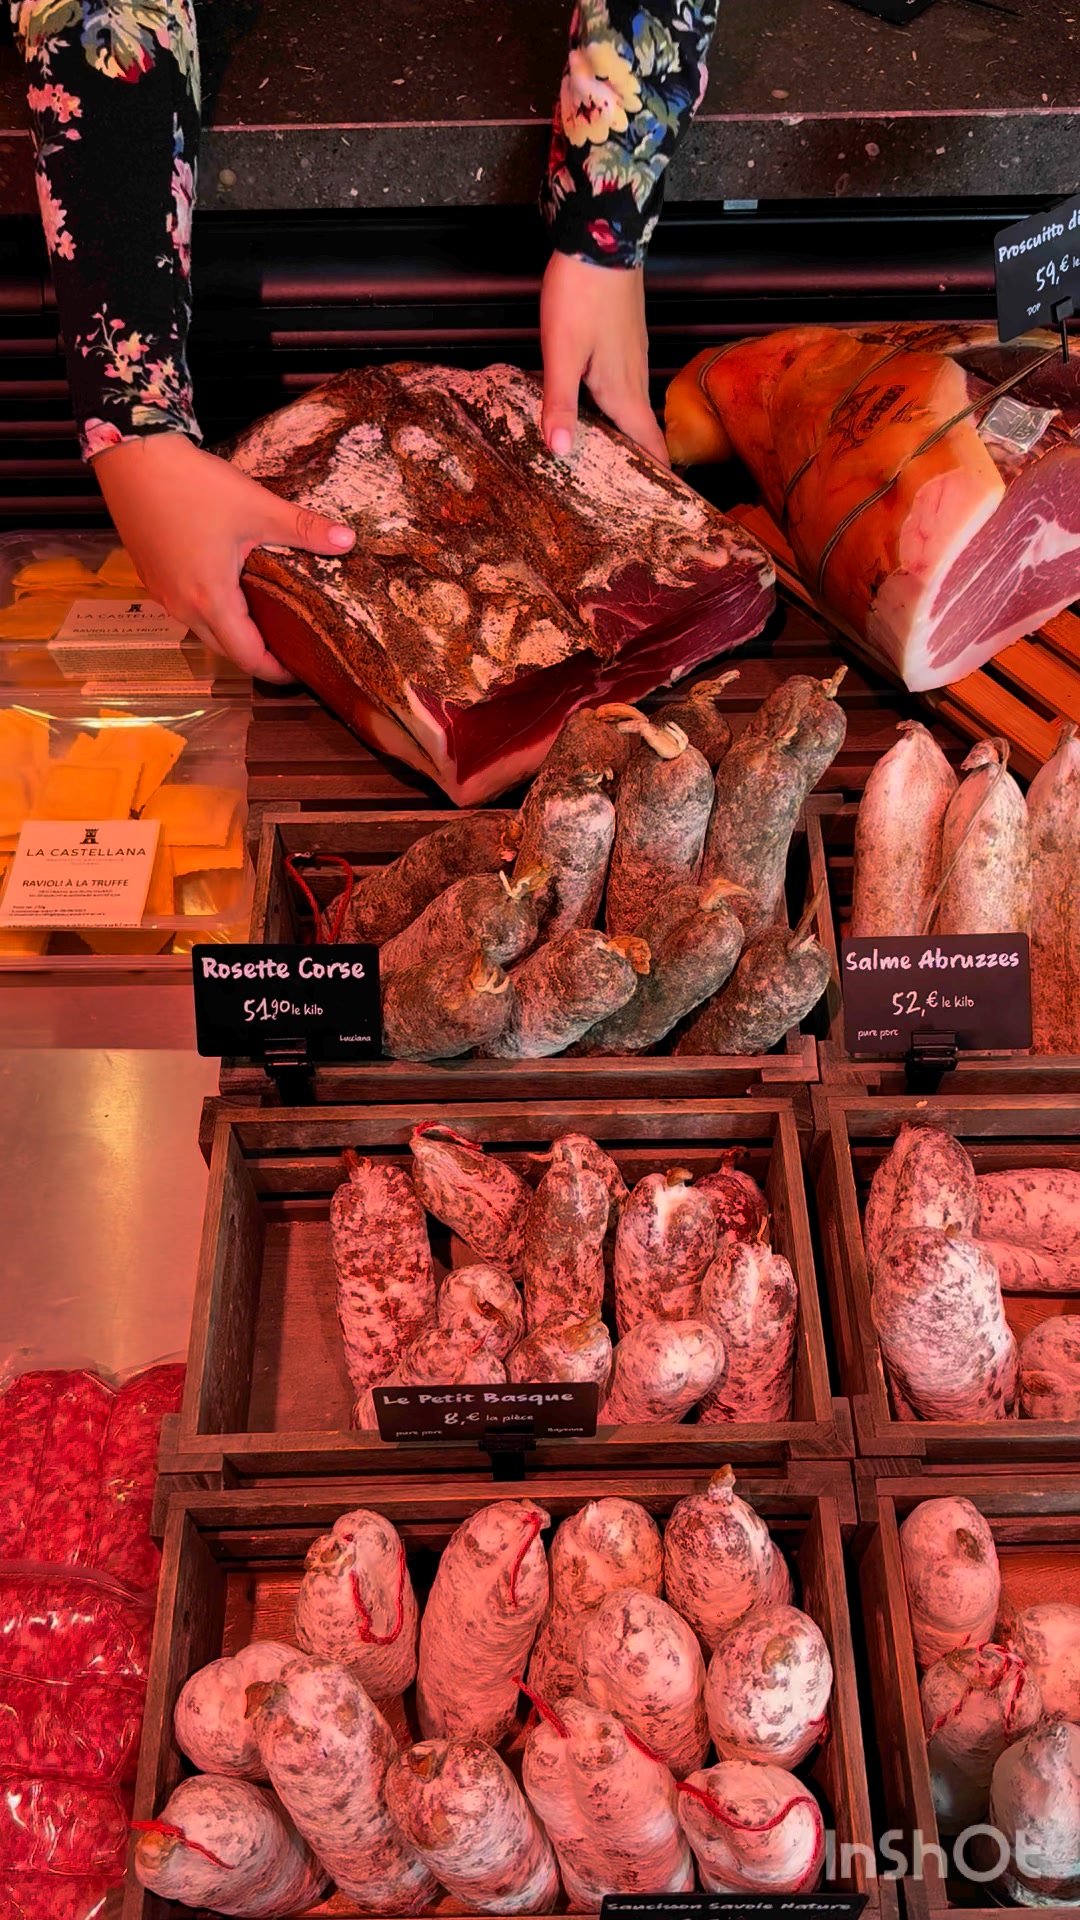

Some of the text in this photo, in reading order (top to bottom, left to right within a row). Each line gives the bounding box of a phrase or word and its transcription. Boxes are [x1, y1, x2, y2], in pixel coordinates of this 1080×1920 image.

[998, 223, 1064, 263] Proscuitto
[1026, 302, 1042, 317] DOP
[26, 848, 147, 857] LA CASTELLANA
[22, 879, 64, 888] RAVIOLI
[76, 879, 88, 887] LA
[92, 879, 129, 887] TRUFFE
[845, 948, 1020, 971] Salme Abruzzes
[201, 956, 366, 980] Rosette Corse
[941, 996, 951, 1008] le
[954, 995, 975, 1008] kilo
[291, 1003, 301, 1015] le
[303, 1004, 324, 1016] kilo
[857, 1028, 899, 1040] pure porc
[383, 1392, 575, 1406] Le Petit Basque
[485, 1414, 499, 1422] la
[502, 1413, 534, 1424] pièce
[607, 1902, 851, 1910] Saucisson Savoie Nature
